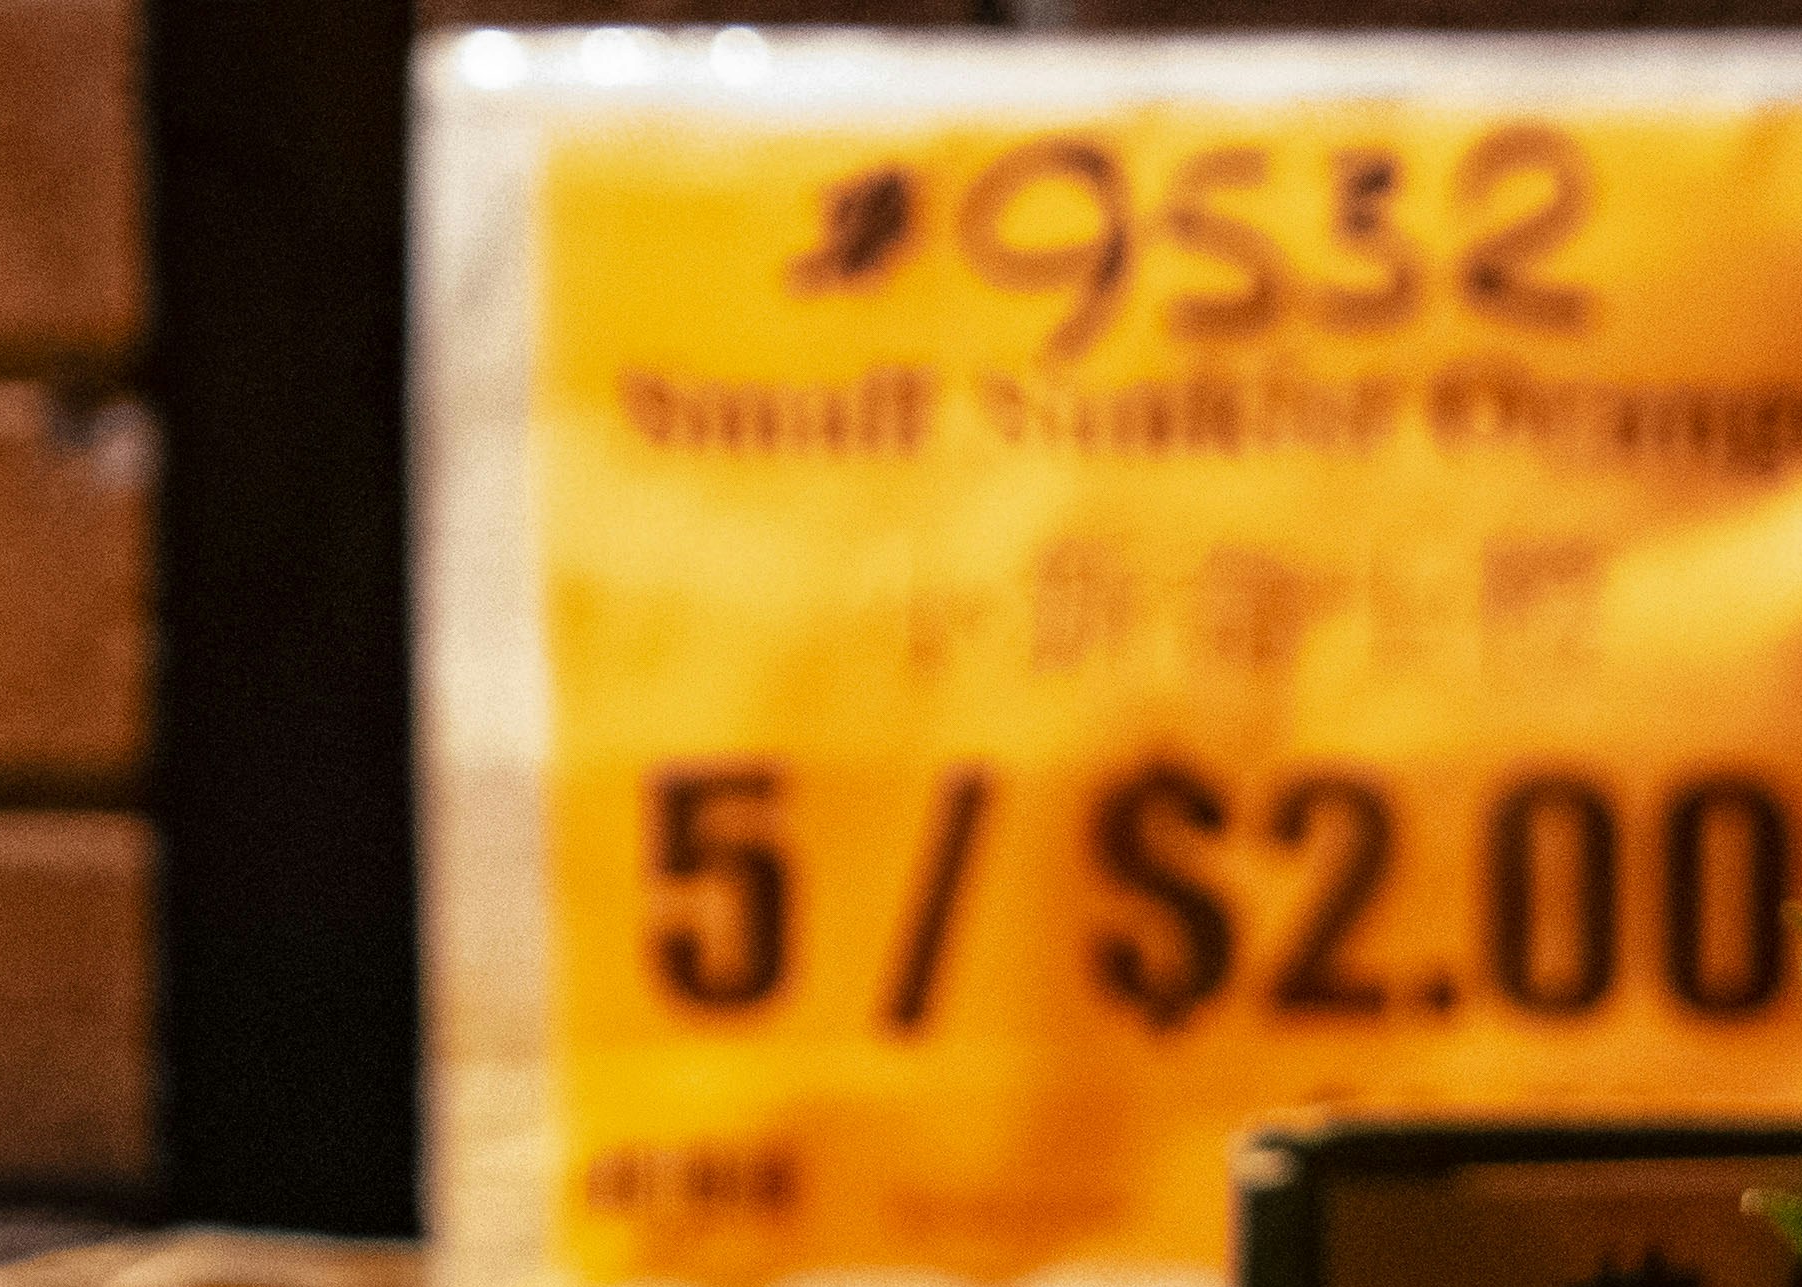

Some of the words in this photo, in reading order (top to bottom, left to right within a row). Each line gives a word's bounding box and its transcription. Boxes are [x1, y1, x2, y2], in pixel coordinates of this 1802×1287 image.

[643, 768, 800, 1021] 5
[879, 768, 994, 1036] /
[1087, 752, 1799, 1034] $2.00
